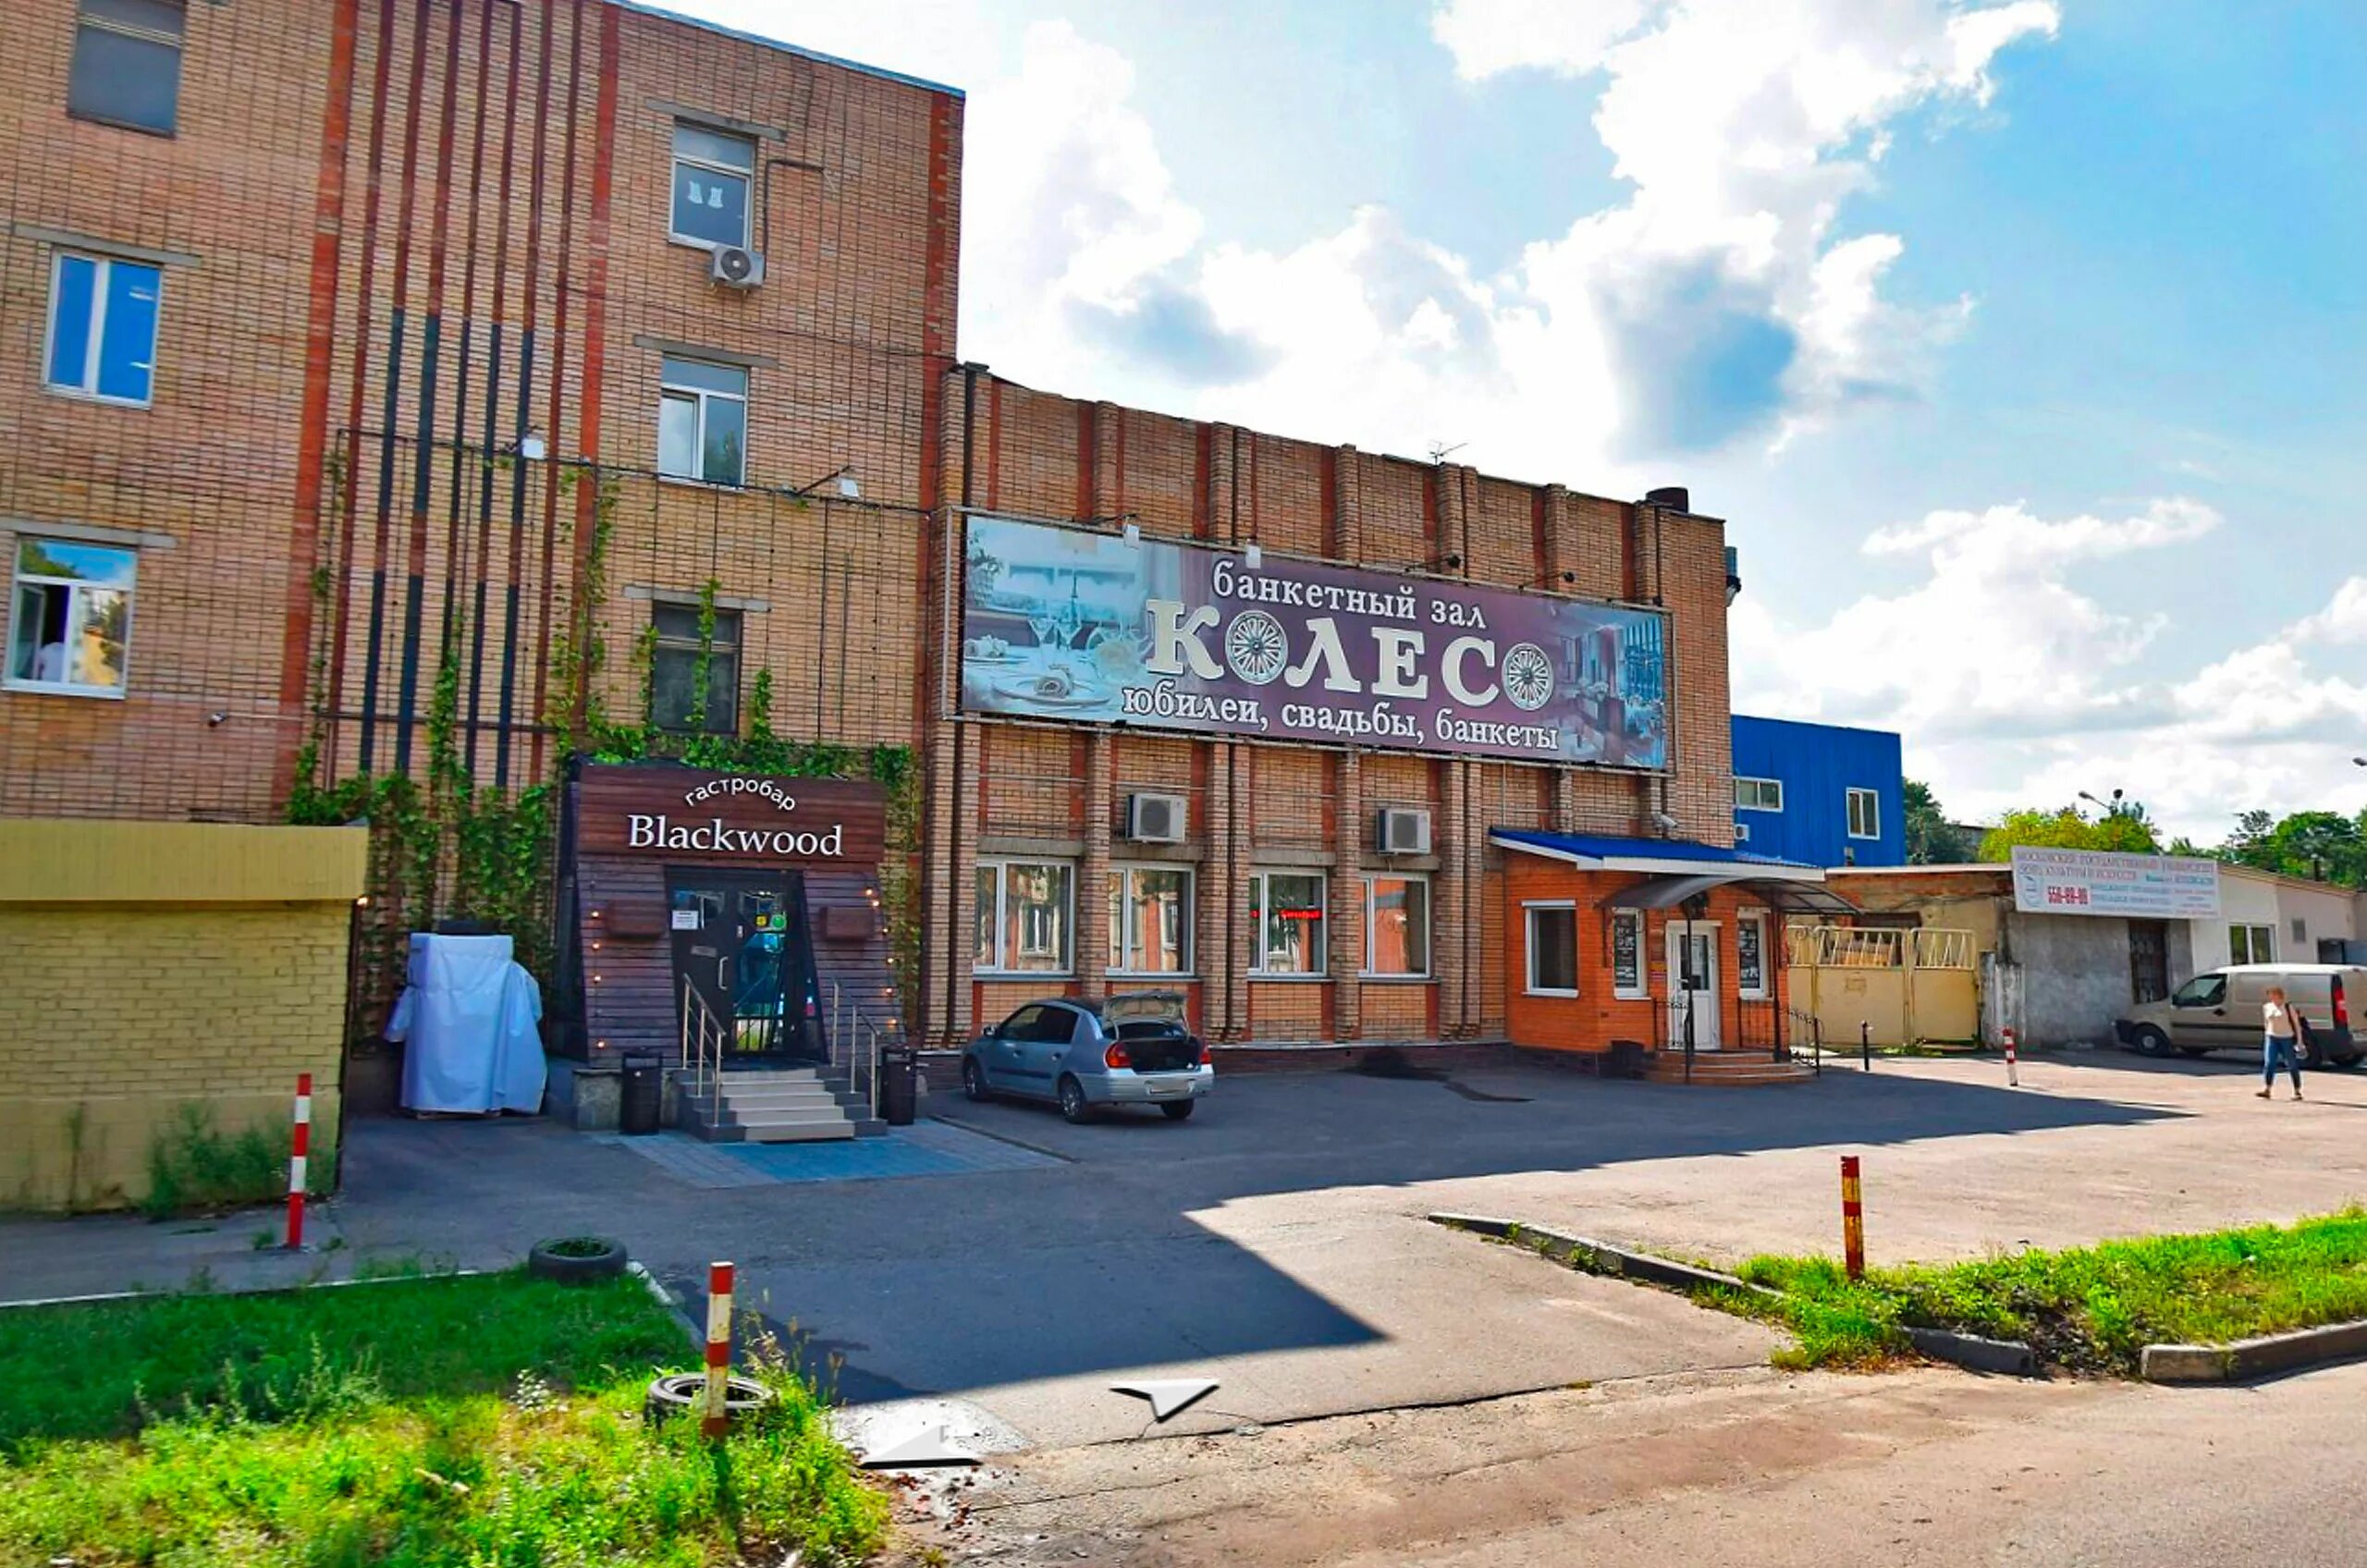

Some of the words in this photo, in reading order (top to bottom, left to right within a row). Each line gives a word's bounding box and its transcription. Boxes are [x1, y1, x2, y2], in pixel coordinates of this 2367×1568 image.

[1212, 558, 1417, 620] банкетный
[1430, 599, 1487, 630] зал
[1146, 598, 1555, 712] КОЛЕСО
[1122, 679, 1269, 731] юбилеи,
[1281, 701, 1426, 744] свадьбы,
[1435, 707, 1560, 750] банкеты
[684, 777, 796, 812] гастробар
[627, 815, 843, 856] Blackwood
